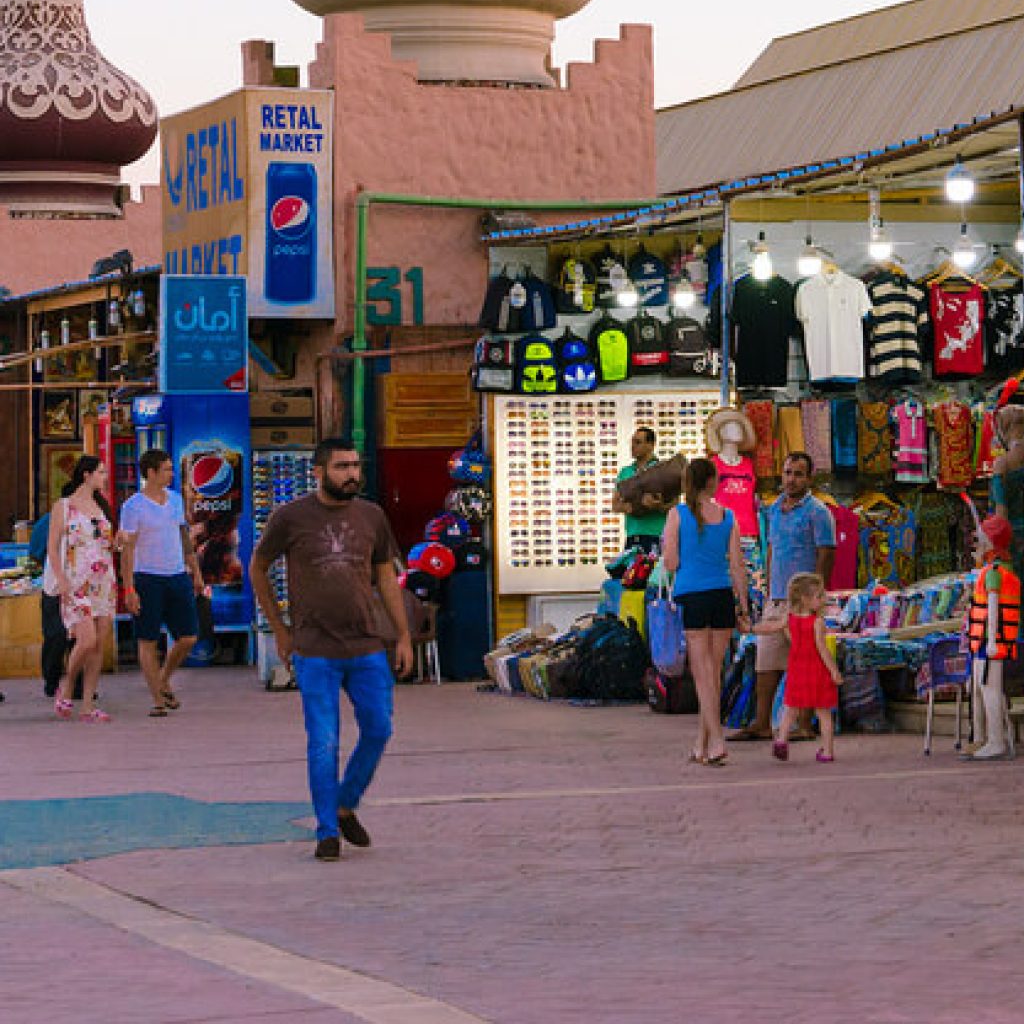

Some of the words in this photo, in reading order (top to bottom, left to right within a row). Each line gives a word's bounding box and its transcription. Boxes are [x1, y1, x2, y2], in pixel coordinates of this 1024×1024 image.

[262, 104, 323, 130] RETAL
[186, 117, 244, 212] RETAL
[260, 132, 324, 152] MARKET
[174, 285, 241, 331] أمان
[366, 267, 424, 326] 31
